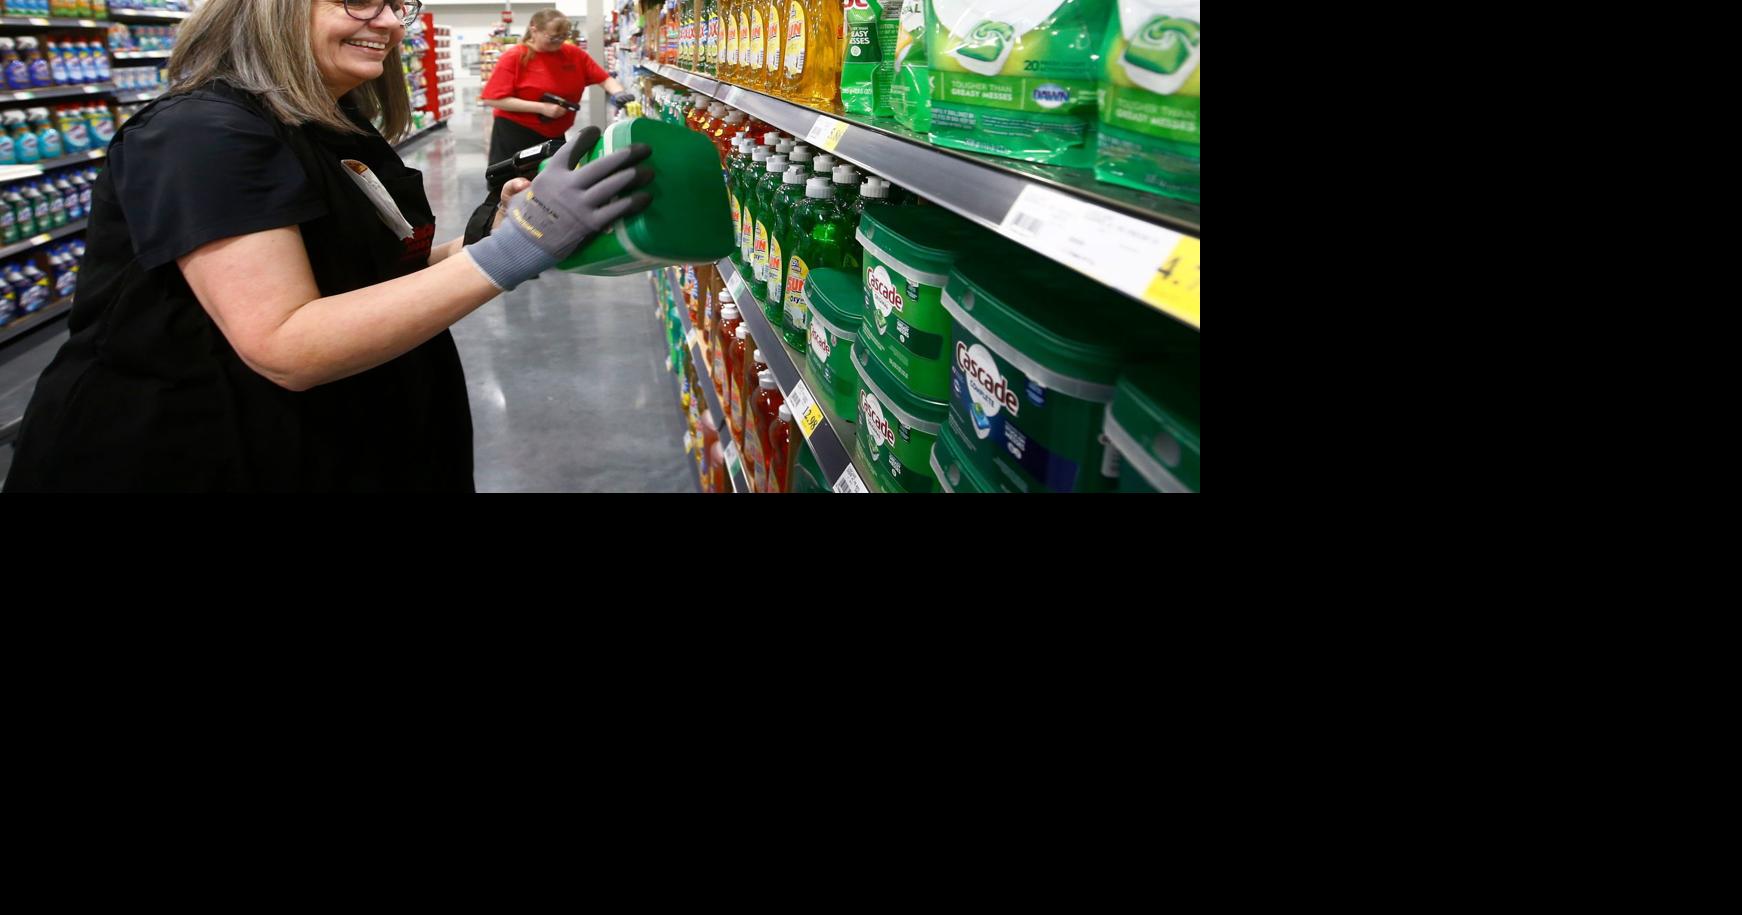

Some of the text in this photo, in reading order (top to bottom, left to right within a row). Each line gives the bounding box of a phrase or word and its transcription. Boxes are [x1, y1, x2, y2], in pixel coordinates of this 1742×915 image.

[1024, 60, 1040, 71] 20
[951, 88, 1013, 101] GREASY MESSES
[1033, 88, 1070, 101] DAWN
[867, 267, 903, 311] Cascade
[809, 323, 831, 354] ascade
[957, 342, 1019, 414] Cascade
[803, 406, 818, 431] 12.98
[861, 389, 894, 446] Cascade
